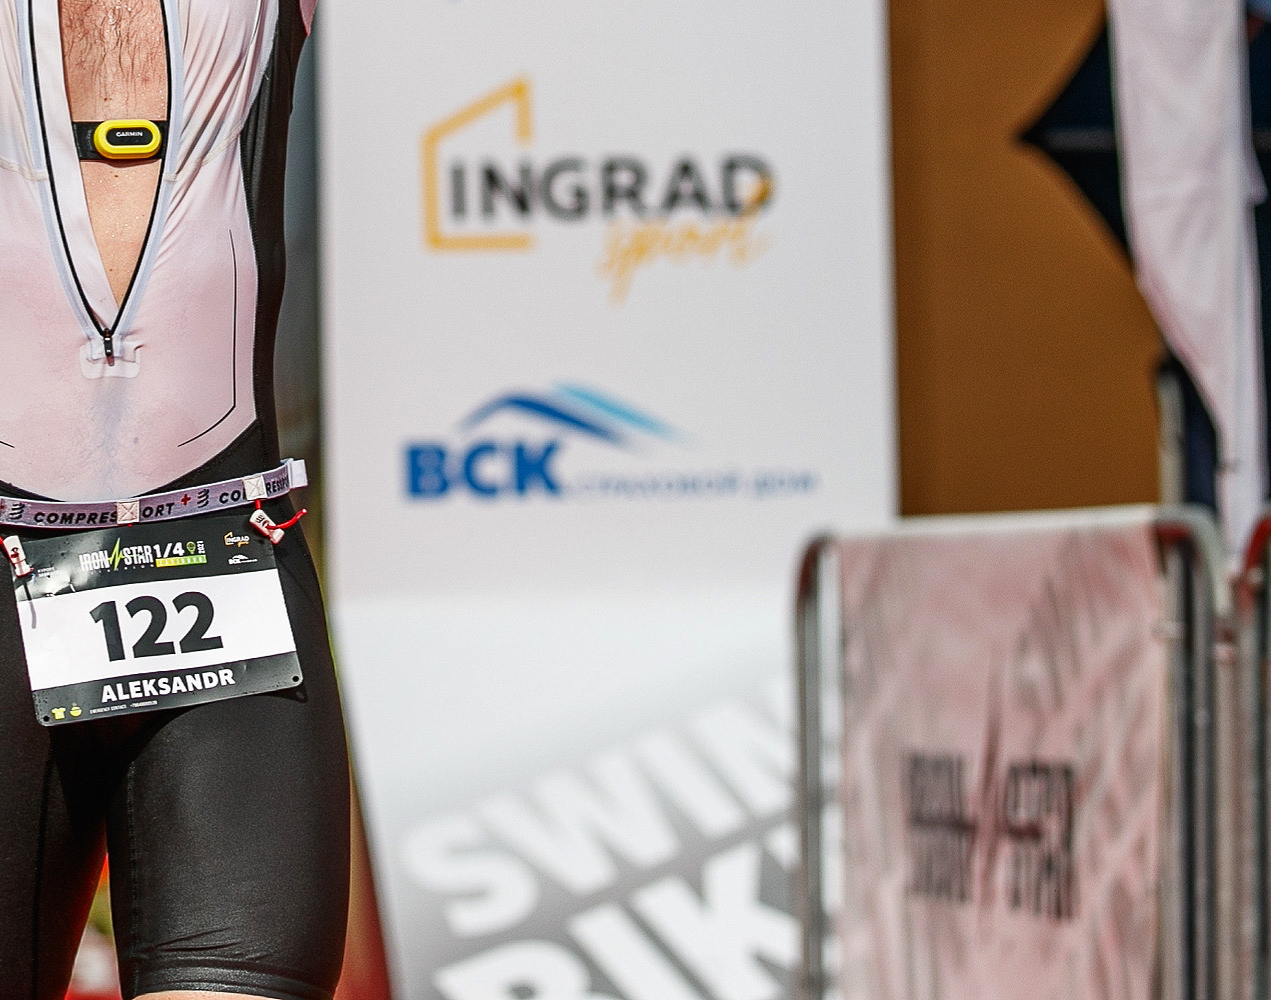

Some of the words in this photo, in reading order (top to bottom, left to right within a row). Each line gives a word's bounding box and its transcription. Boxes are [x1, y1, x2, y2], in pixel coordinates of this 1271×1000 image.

[450, 152, 777, 225] INGRAD
[79, 550, 110, 572] IRON
[122, 545, 154, 566] STAR
[153, 541, 185, 558] 1/4
[89, 591, 224, 662] 122
[101, 668, 236, 703] ALEKSANDR
